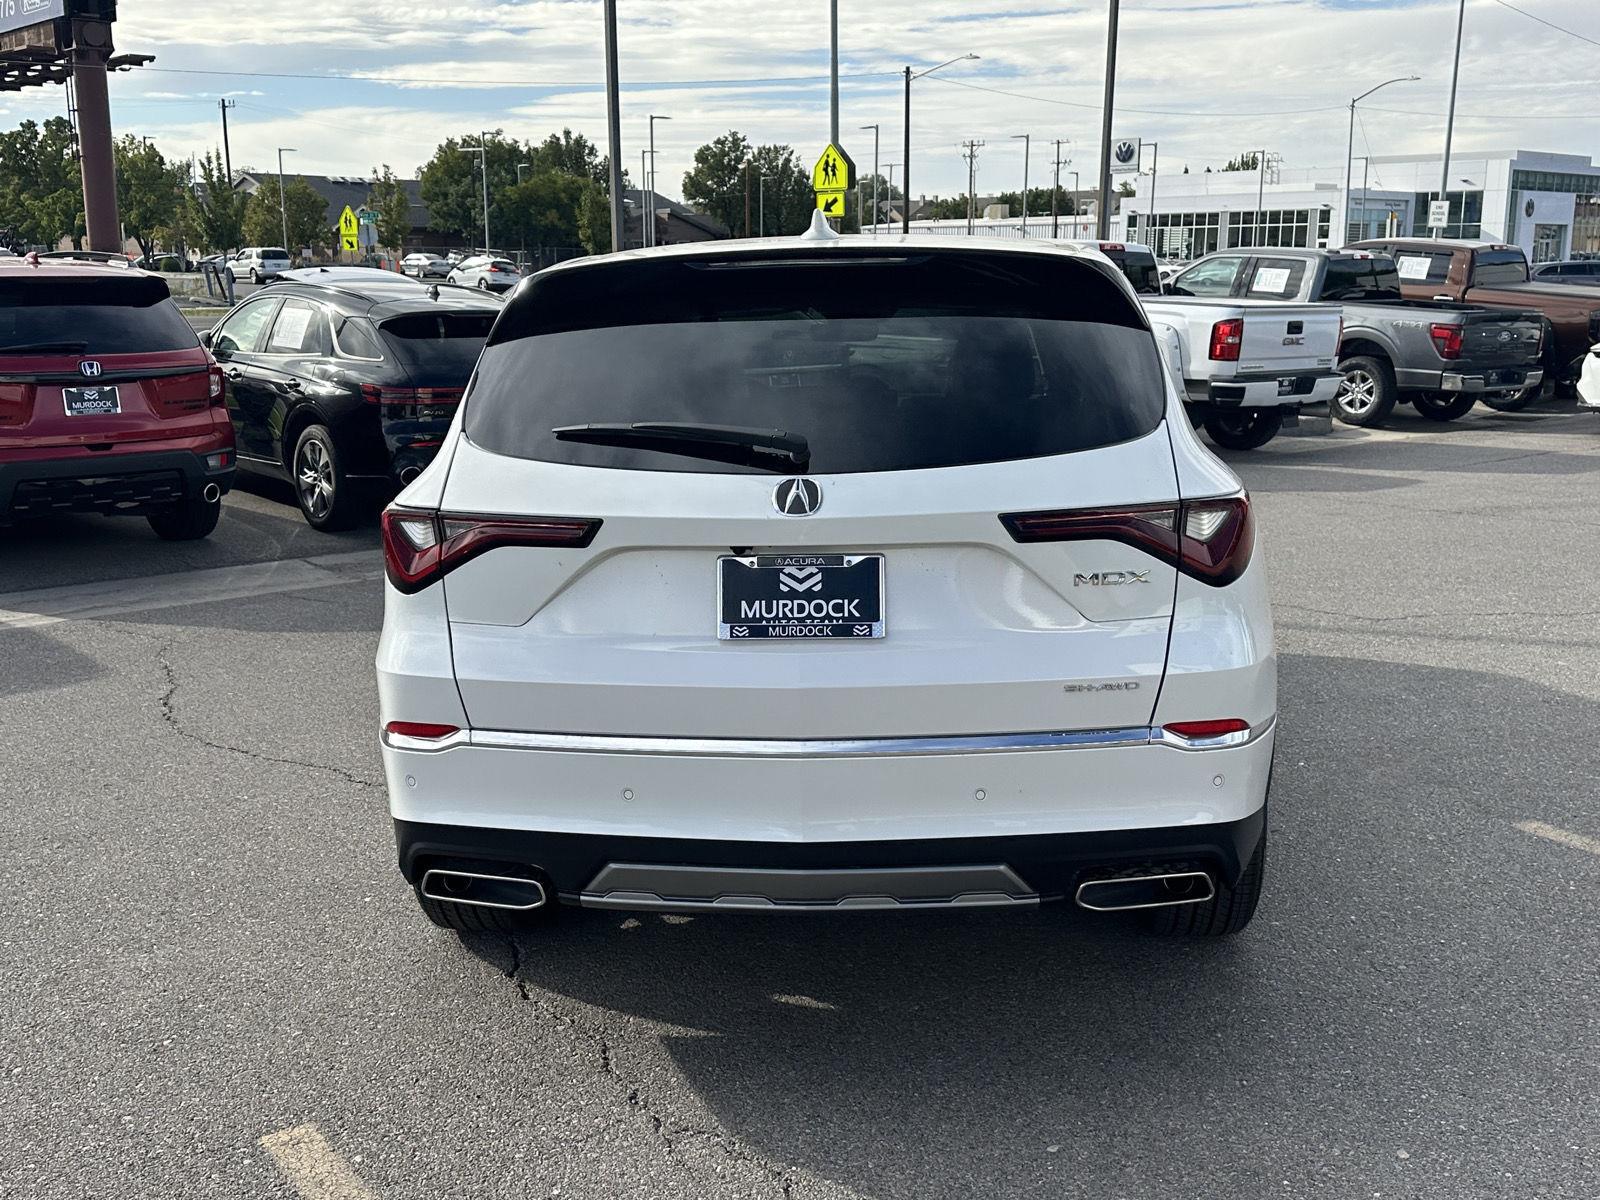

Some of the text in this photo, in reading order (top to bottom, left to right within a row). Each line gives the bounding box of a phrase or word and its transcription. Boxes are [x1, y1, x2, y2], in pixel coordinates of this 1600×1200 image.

[1282, 337, 1305, 346] GMC
[72, 401, 112, 409] MURDOCK
[784, 557, 825, 566] ACURA
[1073, 570, 1151, 587] MDX
[741, 599, 861, 618] MURDOCK
[768, 626, 833, 636] MURDOCK
